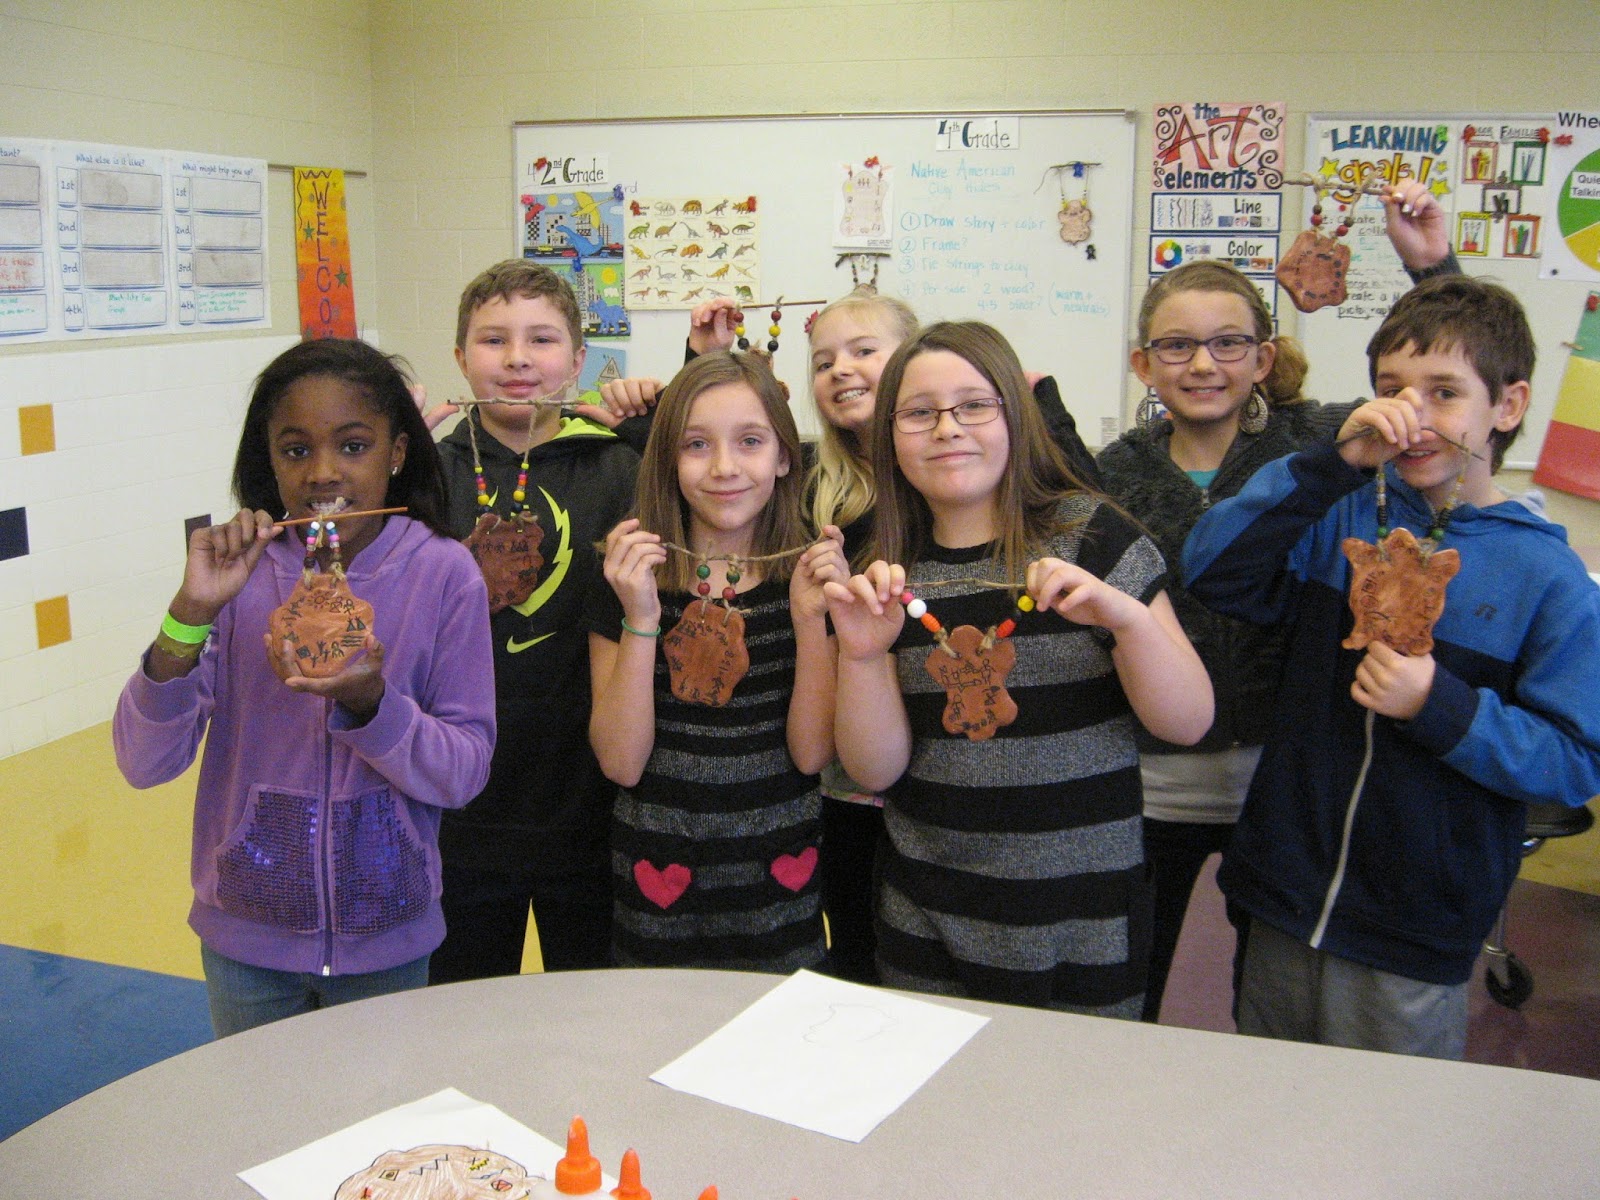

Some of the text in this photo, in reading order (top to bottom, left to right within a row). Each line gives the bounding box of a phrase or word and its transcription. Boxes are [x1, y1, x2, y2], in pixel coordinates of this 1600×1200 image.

[1192, 102, 1220, 119] the
[961, 120, 1011, 148] Grade
[1156, 106, 1261, 170] Art
[1331, 125, 1448, 155] LEARNING
[1501, 126, 1541, 139] FAMILIE
[540, 157, 604, 186] 2nd Grade
[911, 158, 1016, 181] Native American
[1164, 162, 1257, 189] elements
[61, 180, 75, 190] 1st
[175, 187, 187, 197] 1st
[1234, 198, 1262, 214] Line
[924, 213, 956, 228] Draw
[175, 225, 192, 235] 2nd
[1227, 240, 1264, 256] Color
[62, 262, 80, 273] 3rd
[178, 261, 193, 273] 3rd
[65, 303, 83, 316] 4th
